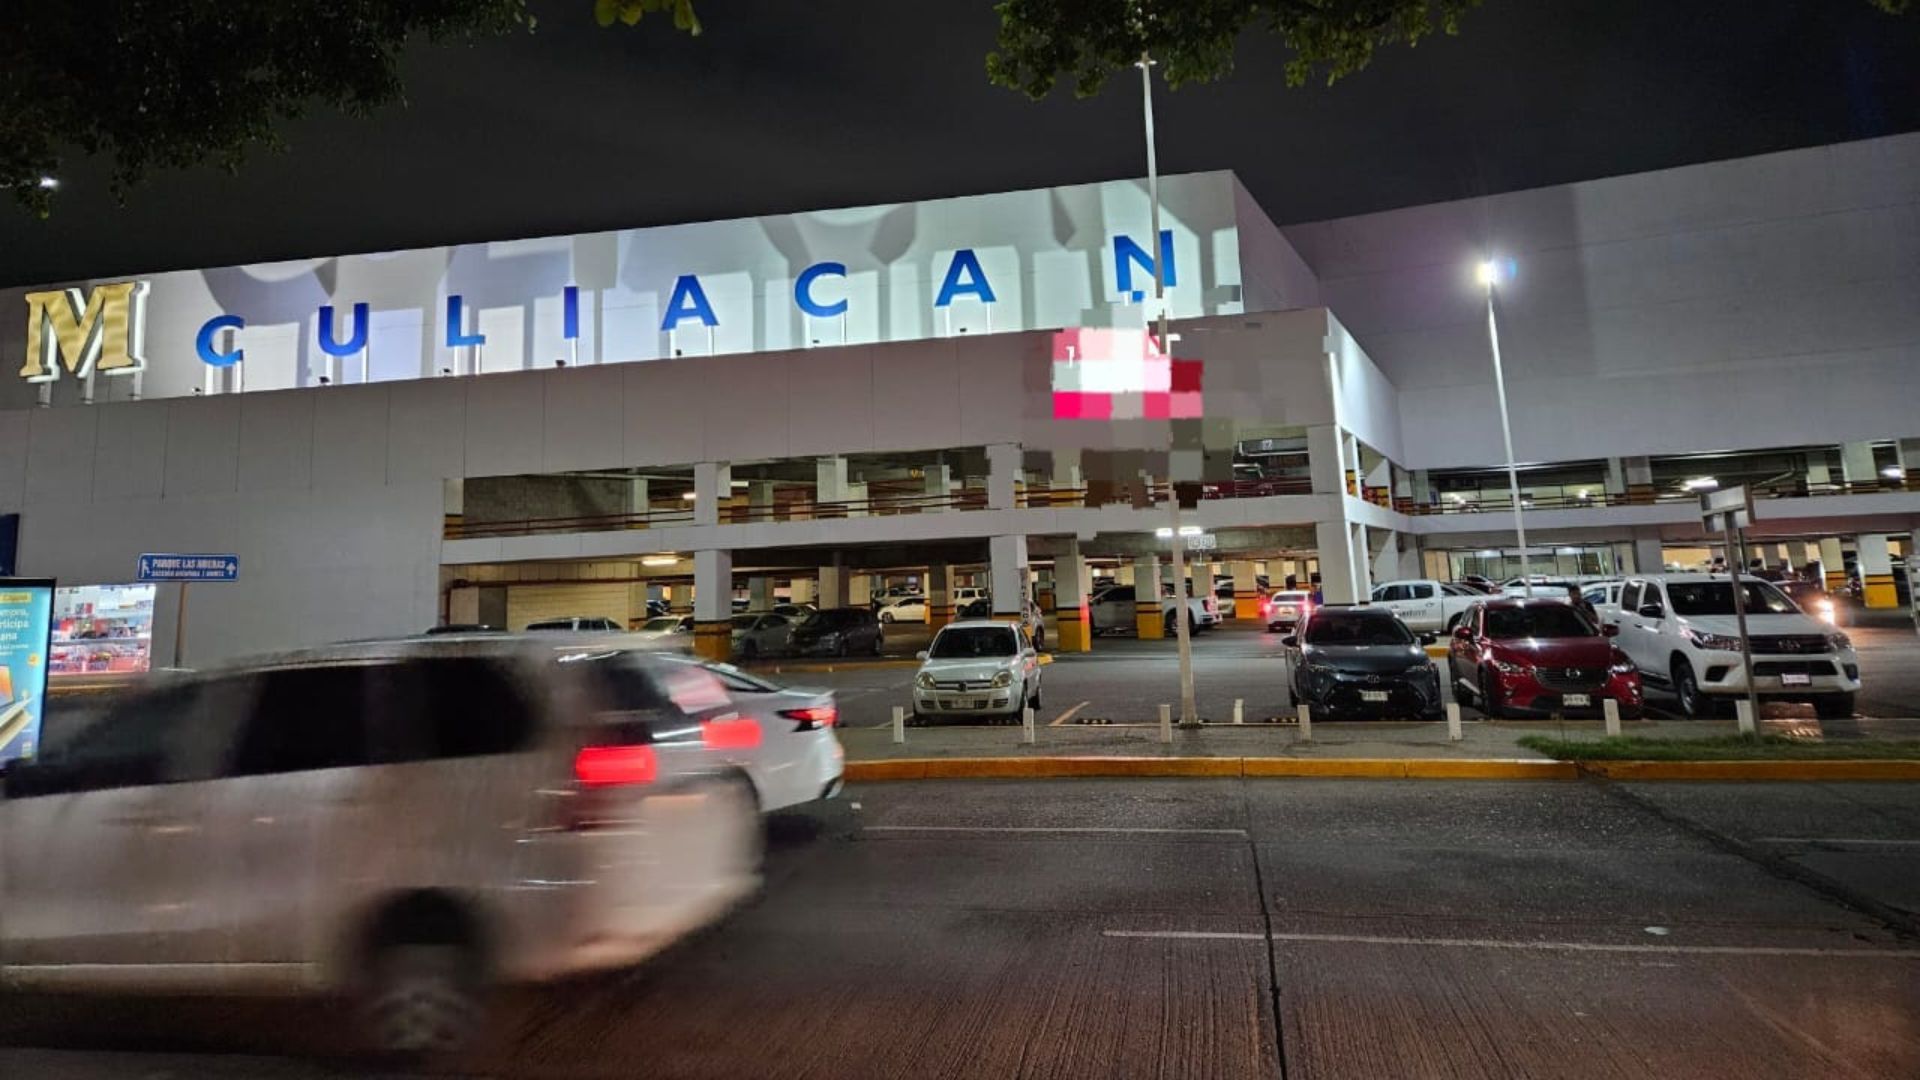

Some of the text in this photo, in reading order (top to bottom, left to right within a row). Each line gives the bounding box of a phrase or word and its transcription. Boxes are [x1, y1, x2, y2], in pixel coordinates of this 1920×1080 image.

[196, 229, 1176, 366] CULIACAN
[152, 559, 181, 569] PARQUE
[182, 559, 196, 569] LAS
